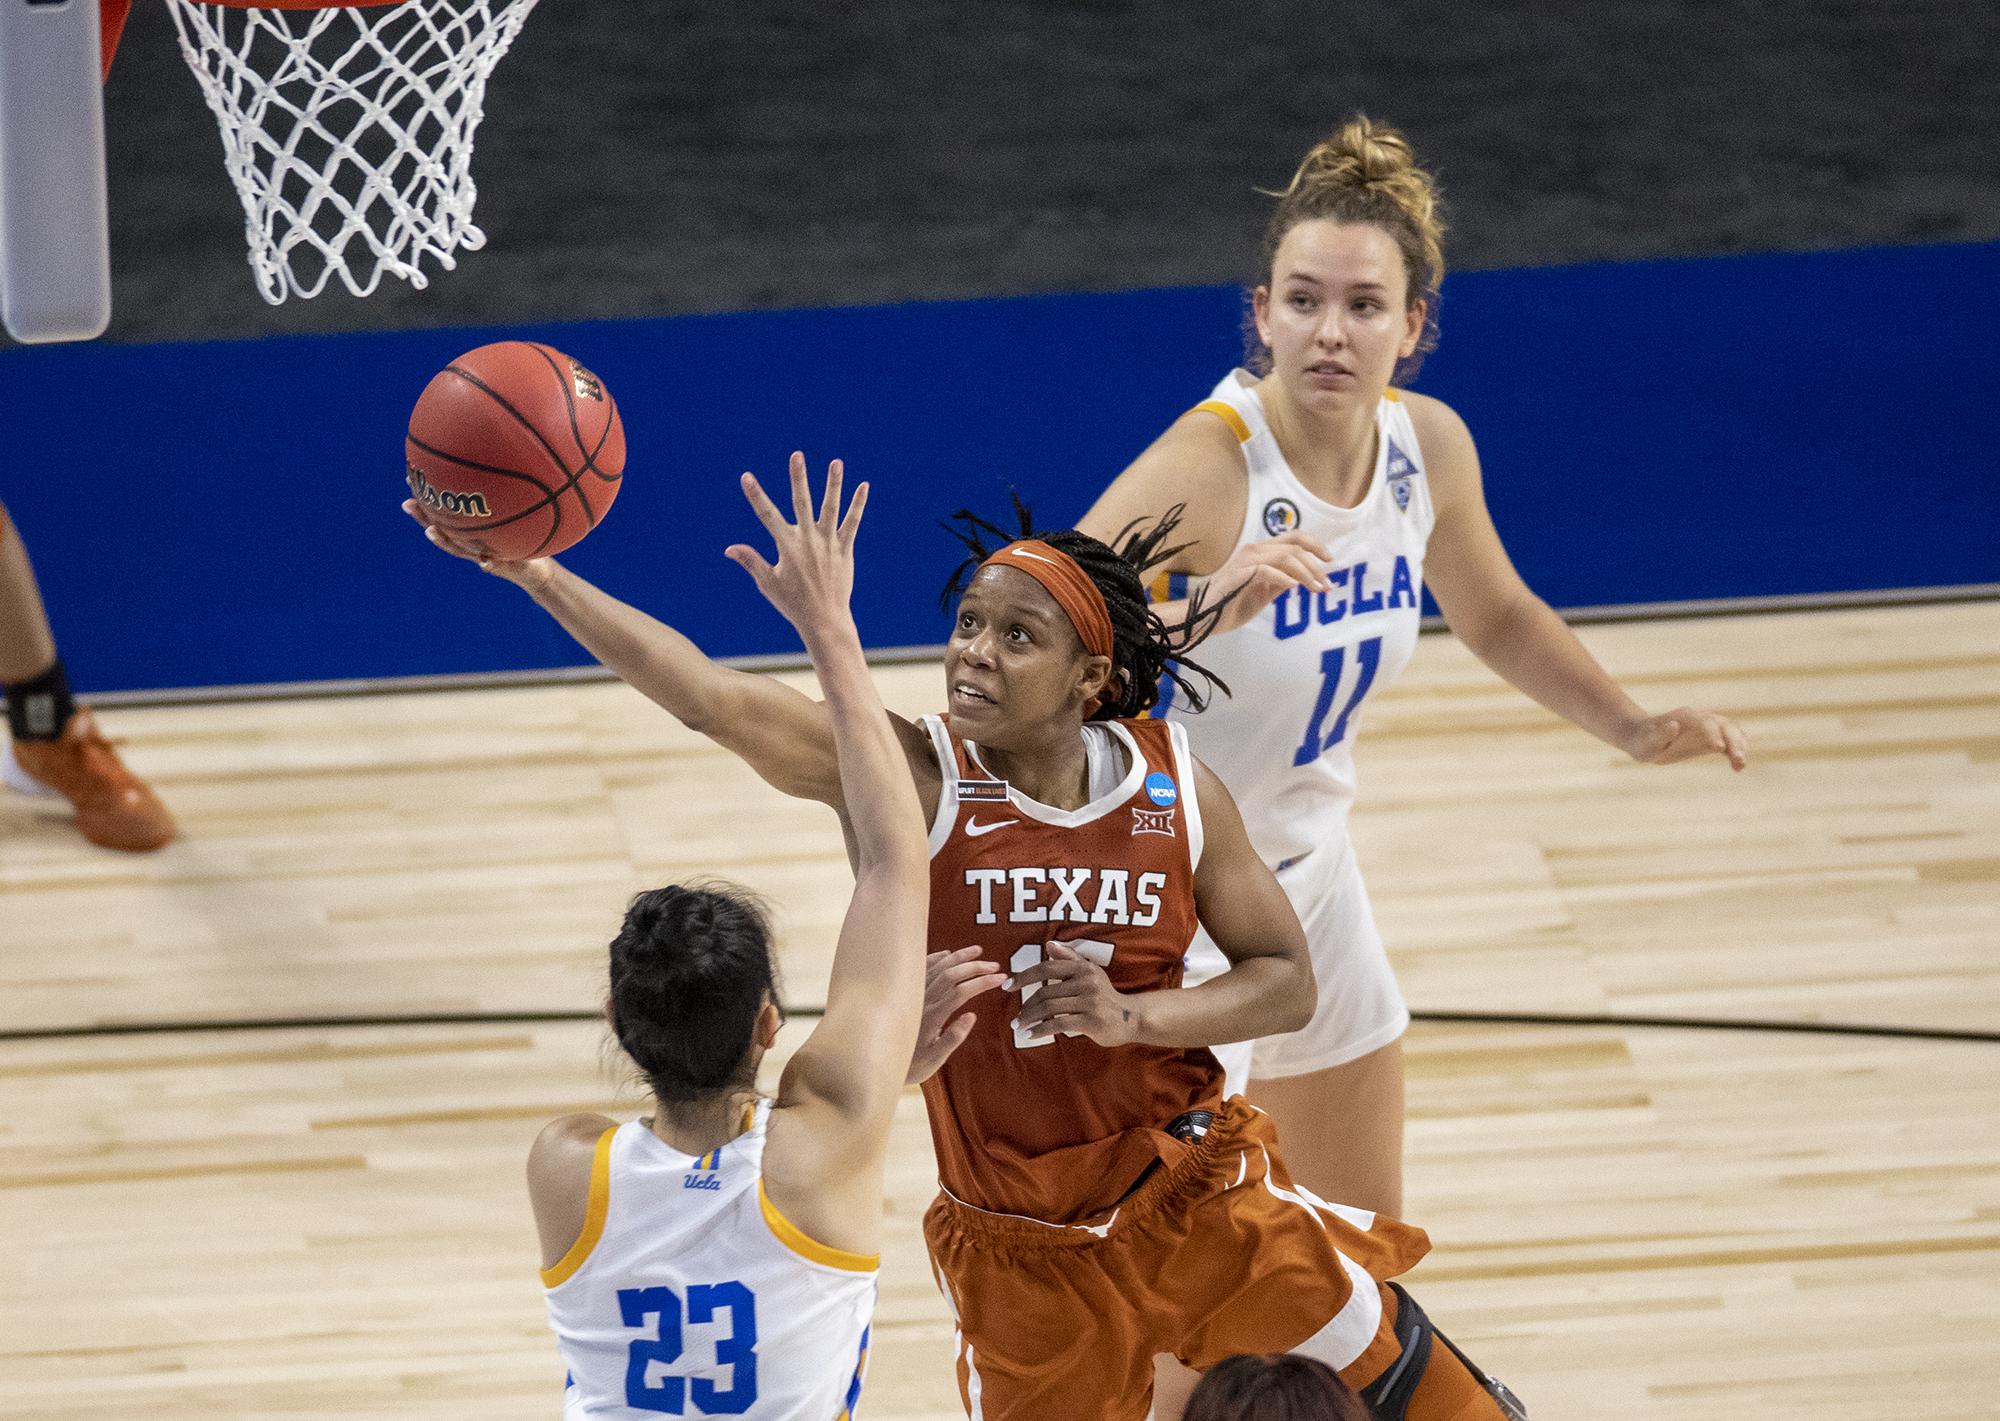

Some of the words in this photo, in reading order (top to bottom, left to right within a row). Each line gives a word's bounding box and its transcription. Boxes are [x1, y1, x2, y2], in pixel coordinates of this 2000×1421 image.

[1272, 555, 1418, 641] UCLA
[1292, 636, 1383, 767] 11
[1150, 787, 1176, 798] NCAA
[964, 867, 1168, 927] TEXAS
[684, 1173, 721, 1191] Ucla
[616, 1280, 759, 1416] 23
